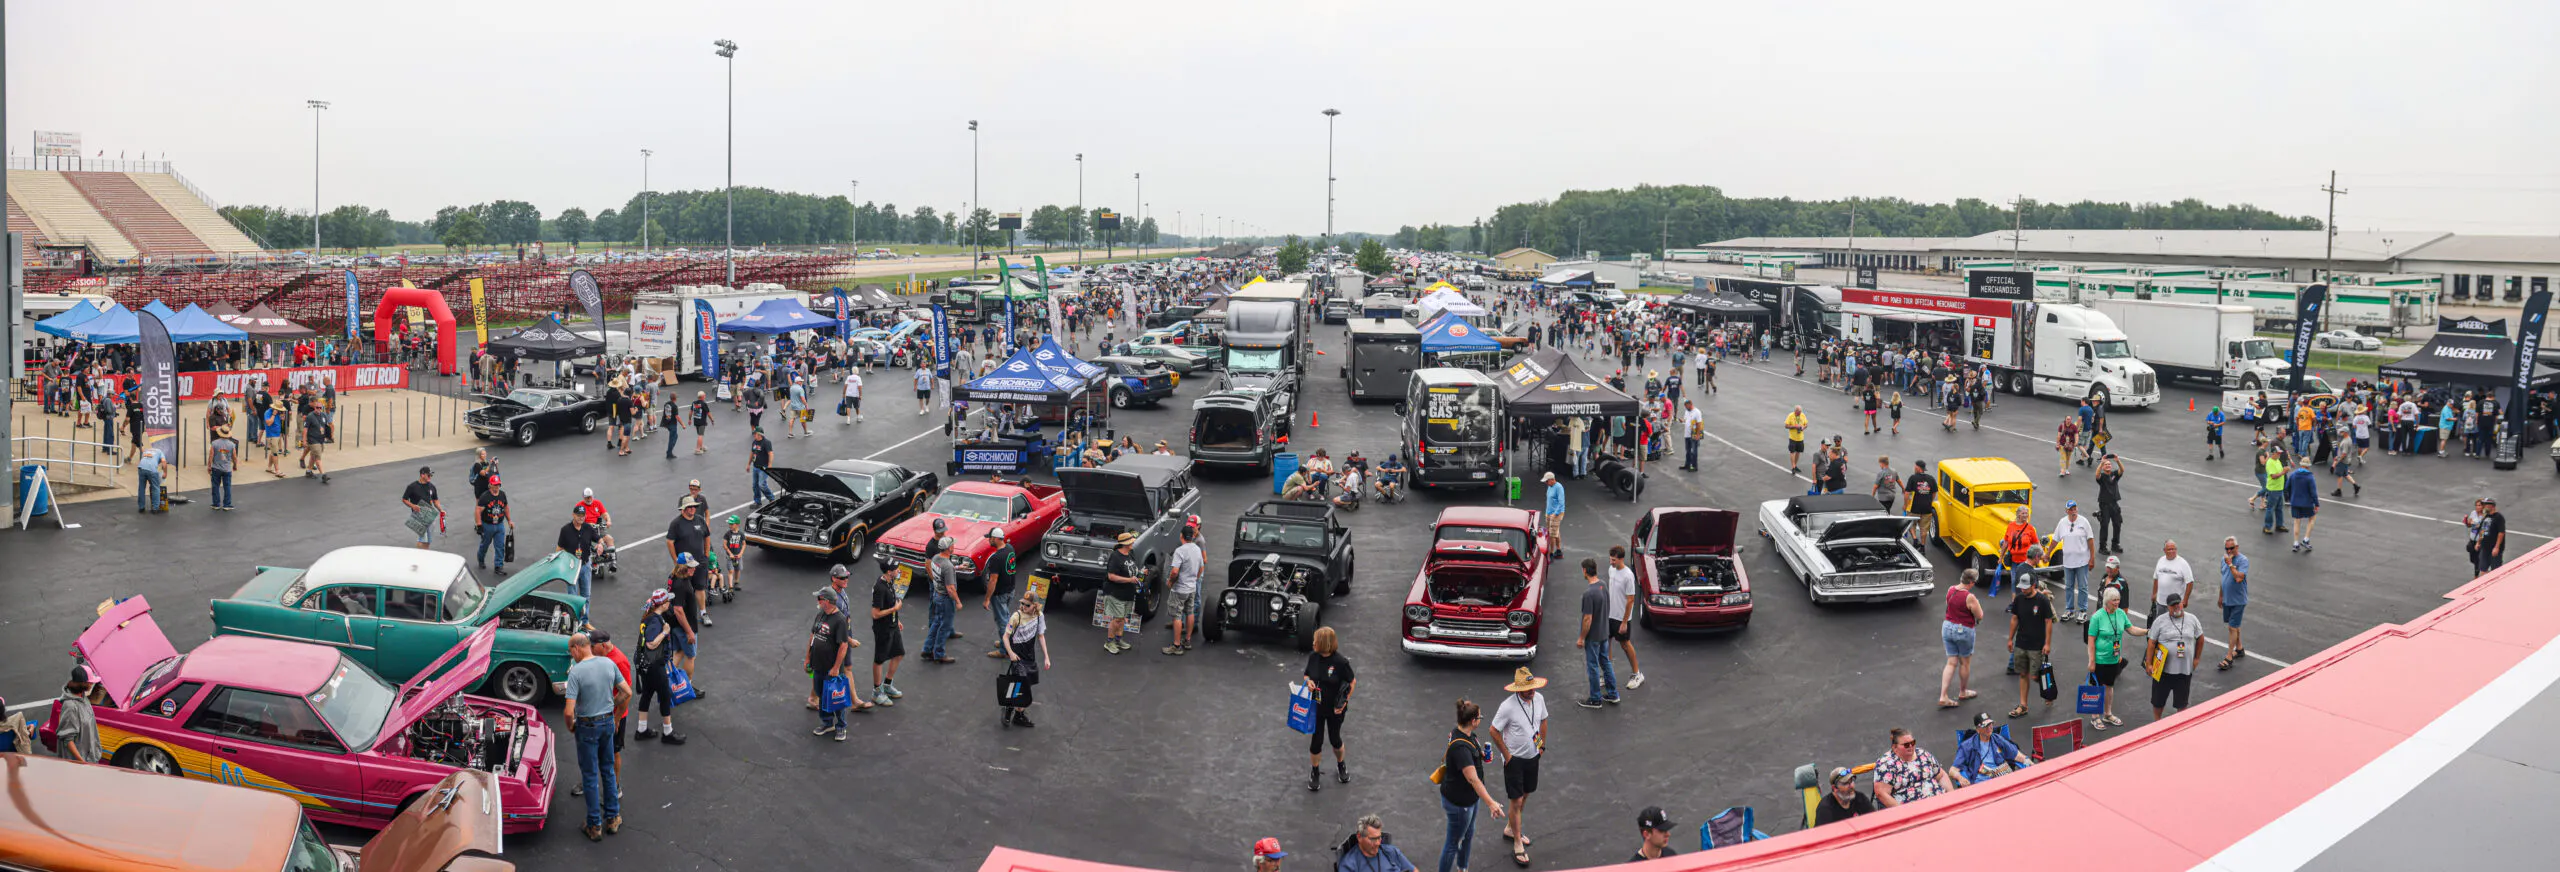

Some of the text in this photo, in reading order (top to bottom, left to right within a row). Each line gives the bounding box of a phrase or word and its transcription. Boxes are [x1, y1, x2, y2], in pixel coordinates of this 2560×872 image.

[1985, 276, 2015, 285] OFFICIAL
[1980, 285, 2021, 295] MERCHANDISE
[2456, 321, 2489, 331] HAGERTY
[937, 323, 946, 361] RICHMOND
[2297, 318, 2313, 368] HAGERTY
[2434, 346, 2497, 360] HAGERTY
[2518, 331, 2538, 390] HAGERTY
[356, 366, 400, 387] HOT ROD
[216, 373, 267, 394] HOT RD
[999, 379, 1042, 388] RICHMOND
[1012, 393, 1048, 401] RICHMOND
[978, 451, 1015, 462] RICHMOND
